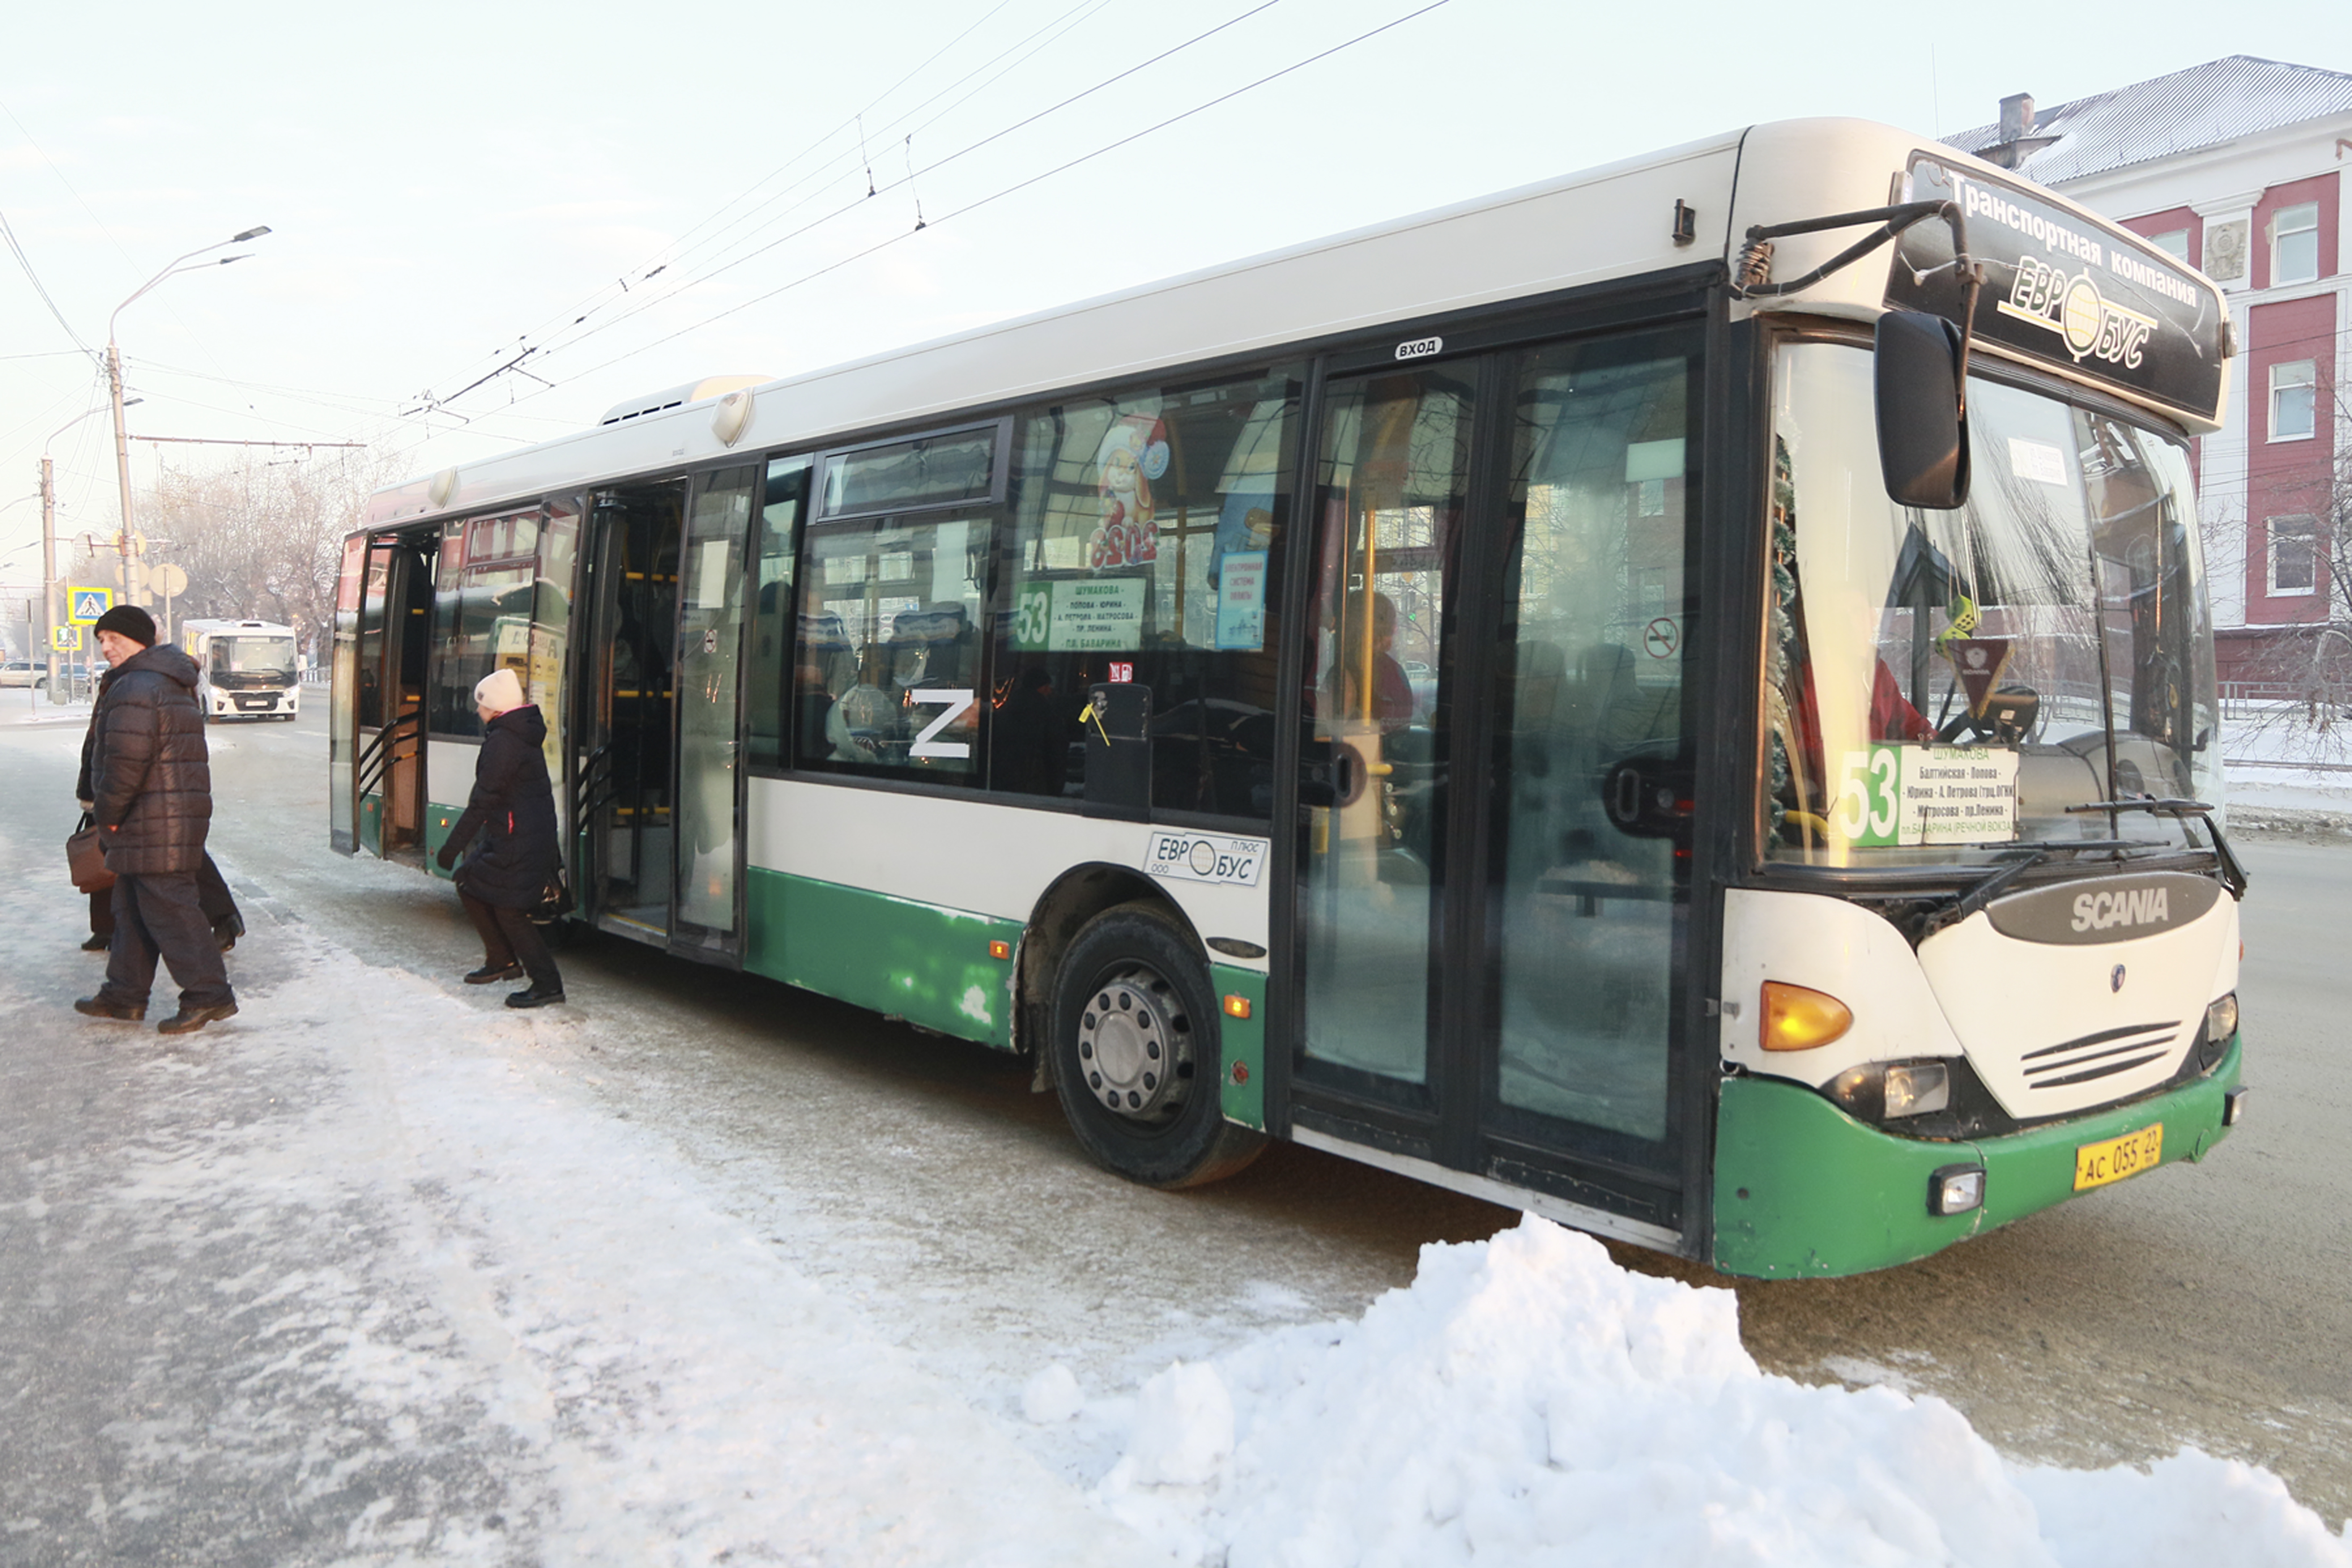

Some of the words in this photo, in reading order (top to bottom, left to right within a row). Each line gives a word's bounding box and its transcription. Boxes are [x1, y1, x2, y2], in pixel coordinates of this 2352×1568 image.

[1948, 170, 2102, 265] Транспортная
[2110, 250, 2197, 307] компания
[1399, 340, 1436, 357] ВХОД
[1075, 586, 1119, 595] ШУМАКОВА
[1017, 592, 1047, 643] 53
[1080, 639, 1121, 648] БАВАРИНА
[909, 689, 974, 758] Z
[1934, 748, 1990, 760] ШУМАКОВА
[1919, 766, 1965, 779] Балтийская
[1971, 767, 1997, 779] Попова
[1838, 749, 1897, 839] 53
[1907, 785, 1933, 798] Юрина
[1947, 785, 1977, 798] Петрова
[1231, 841, 1259, 853] ПЛЮС
[1151, 864, 1169, 874] ООО
[2071, 887, 2169, 932] SCANIA
[2084, 1156, 2106, 1182] АС
[2113, 1138, 2138, 1173] 055
[2145, 1129, 2157, 1154] 22
